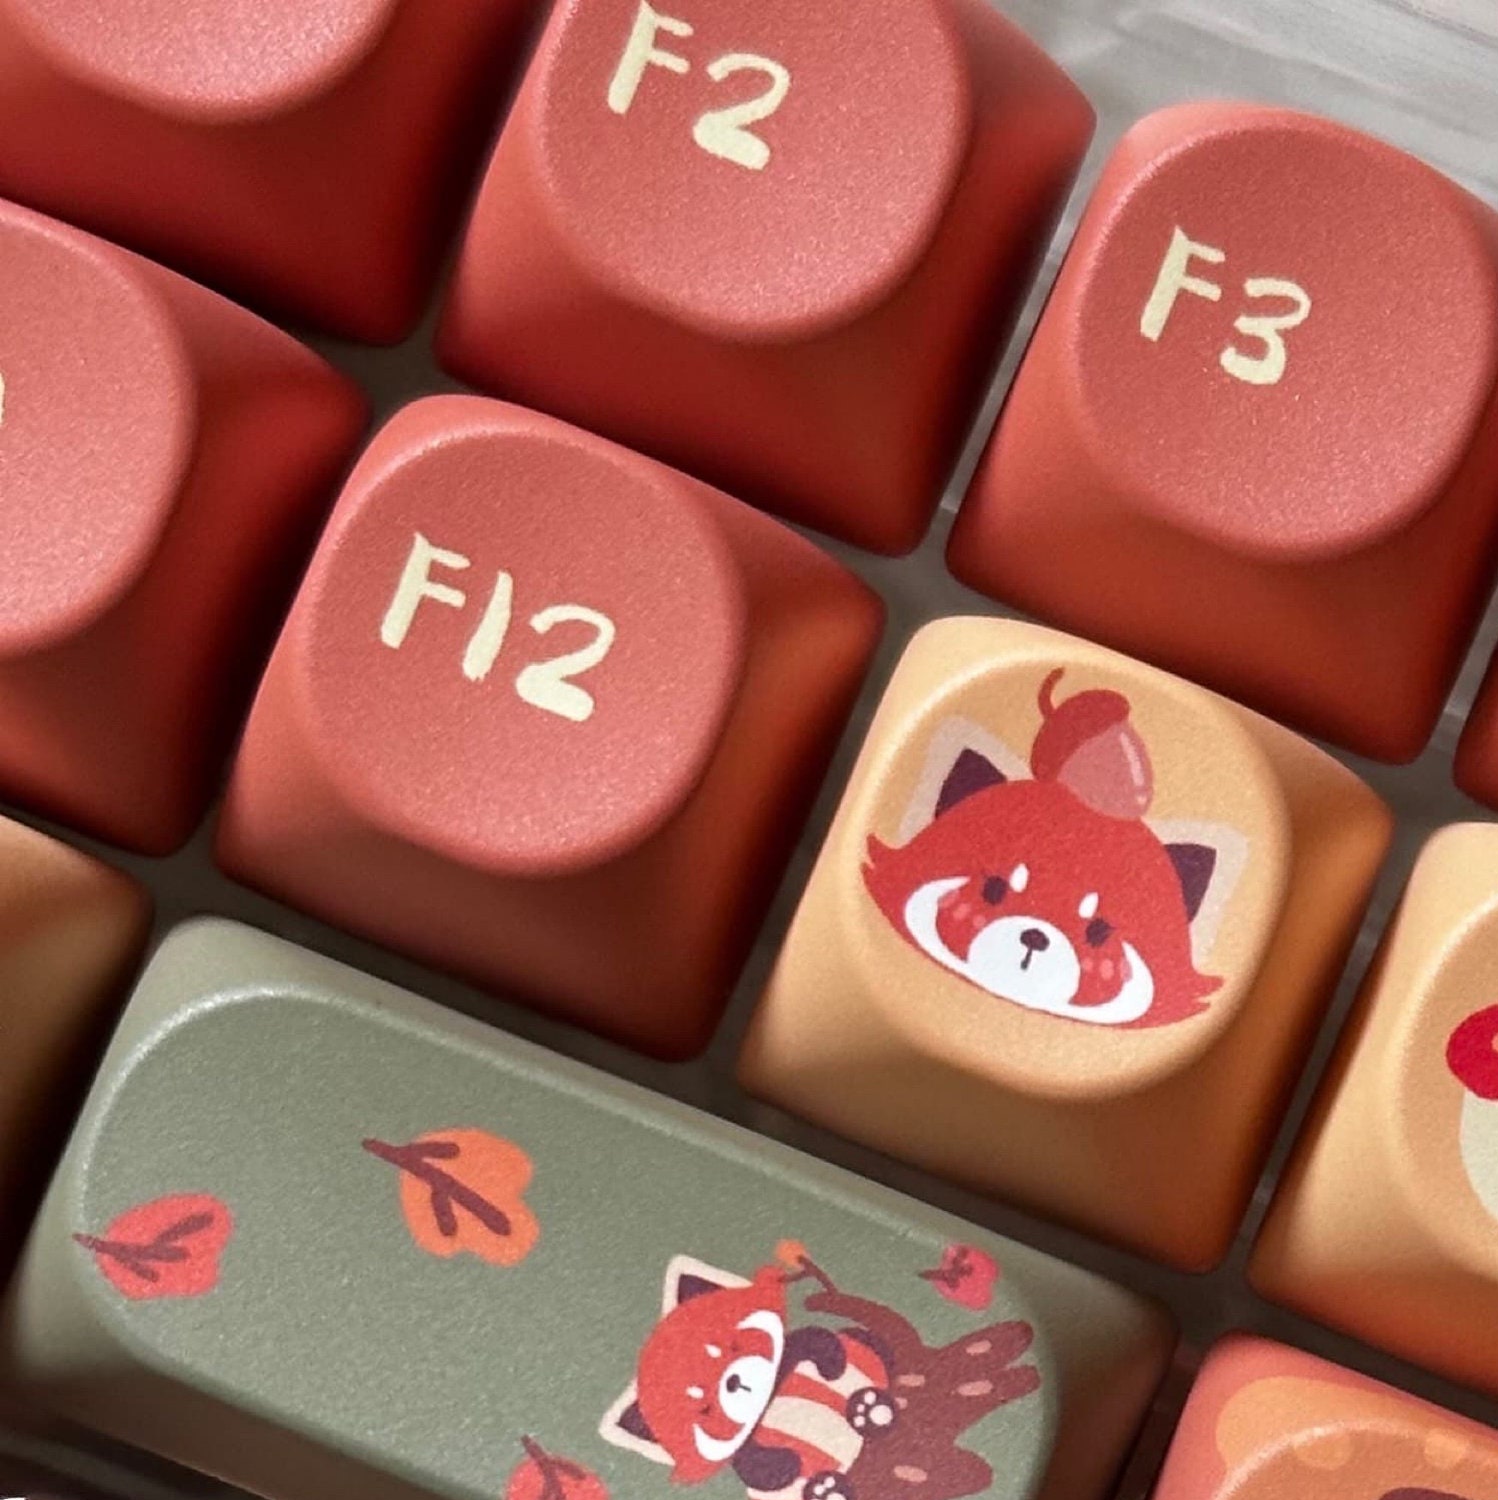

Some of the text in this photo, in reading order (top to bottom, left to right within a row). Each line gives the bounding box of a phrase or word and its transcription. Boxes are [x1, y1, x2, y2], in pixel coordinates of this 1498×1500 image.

[607, 0, 791, 170] F2
[1140, 227, 1312, 385] F3
[380, 533, 617, 722] F12
